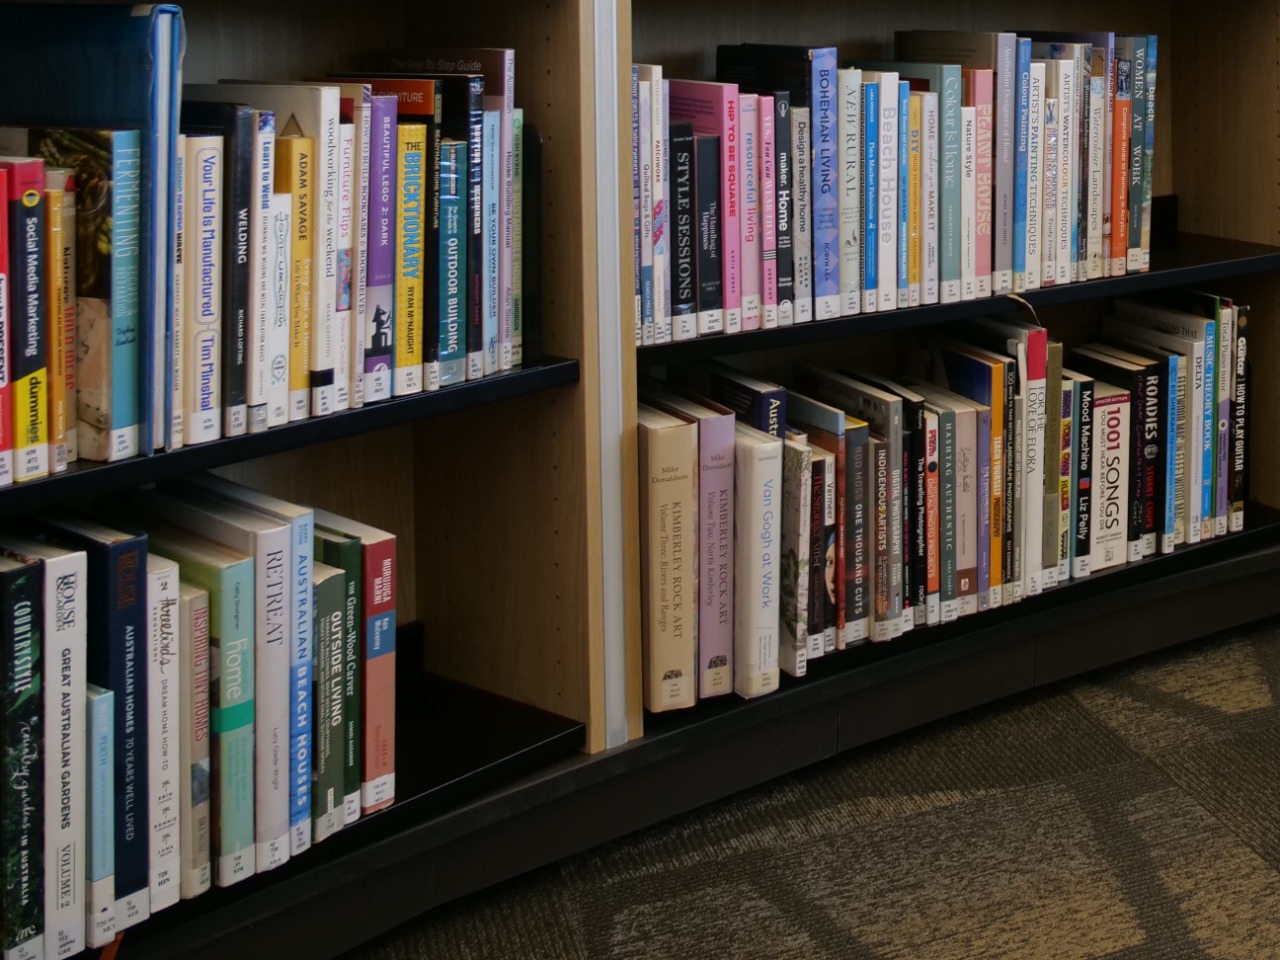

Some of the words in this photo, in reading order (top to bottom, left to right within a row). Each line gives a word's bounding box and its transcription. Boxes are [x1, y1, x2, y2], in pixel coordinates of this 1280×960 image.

[1136, 48, 1144, 98] WOMEN
[727, 100, 735, 121] HIP
[819, 70, 829, 141] BOHEMIAN
[1031, 76, 1040, 124] ARTIST'S
[1135, 115, 1142, 130] AT
[382, 116, 391, 170] BEAUTIFUL
[405, 141, 422, 151] THE
[727, 125, 735, 141] TO
[727, 145, 735, 158] BE
[882, 107, 896, 170] Beach
[1030, 126, 1039, 181] PAINTING
[203, 155, 216, 186] Your
[299, 152, 307, 188] ADAM
[342, 138, 353, 201] Furniture
[382, 173, 390, 199] LEGO
[676, 152, 690, 209] STYLE
[727, 160, 736, 217] SQUARE
[745, 132, 757, 204] resourceful
[779, 152, 787, 187] maker.
[820, 144, 831, 194] LIVING
[1132, 145, 1141, 185] WORK
[202, 187, 214, 214] Life
[202, 215, 213, 227] Is
[299, 193, 307, 241] SAVAGE
[339, 205, 350, 238] Flips
[402, 152, 422, 280] BRICKTIONARY
[779, 191, 788, 231] Home
[882, 178, 896, 244] House
[1028, 185, 1037, 255] TECHNIQUES
[27, 217, 38, 250] Social
[238, 208, 247, 263] WELDING
[381, 219, 390, 246] DARK
[744, 207, 755, 242] living
[26, 254, 37, 285] Media
[200, 229, 216, 317] Manufactured
[446, 237, 459, 295] OUTDOOR
[678, 214, 691, 300] SESSIONS
[25, 289, 37, 356] Marketing
[203, 335, 214, 356] Tim
[446, 298, 459, 353] BUILDING
[201, 358, 213, 411] Minshal
[1194, 356, 1202, 390] DELTA
[29, 376, 42, 443] dummies
[1082, 390, 1090, 420] Mood
[1145, 375, 1158, 439] ROADIES
[1081, 423, 1090, 470] Machine
[1107, 407, 1120, 451] 1001
[763, 478, 774, 506] Van
[825, 481, 834, 520] Vermeer
[1105, 455, 1120, 529] SONGS
[672, 501, 682, 571] KIMBERLEY
[719, 489, 728, 559] KIMBERLEY
[761, 510, 773, 548] Gogh
[1081, 515, 1089, 540] Pelly
[719, 562, 728, 598] ROCK
[762, 554, 772, 567] at
[266, 549, 284, 646] RETREAT
[297, 554, 308, 658] AUSTRALIAN
[673, 574, 682, 610] ROCK
[720, 601, 728, 625] ART
[762, 571, 773, 609] Work
[331, 611, 342, 662] OUTSIDE
[673, 613, 683, 639] ART
[61, 648, 71, 681] GREAT
[223, 640, 245, 698] home
[296, 667, 308, 728] BEACH
[331, 667, 342, 726] LIVING
[61, 685, 71, 758] AUSTRALIAN
[296, 734, 307, 806] HOUSES
[61, 769, 71, 830] GARDENS
[60, 845, 70, 892] VOLUME
[60, 897, 70, 909] 2
